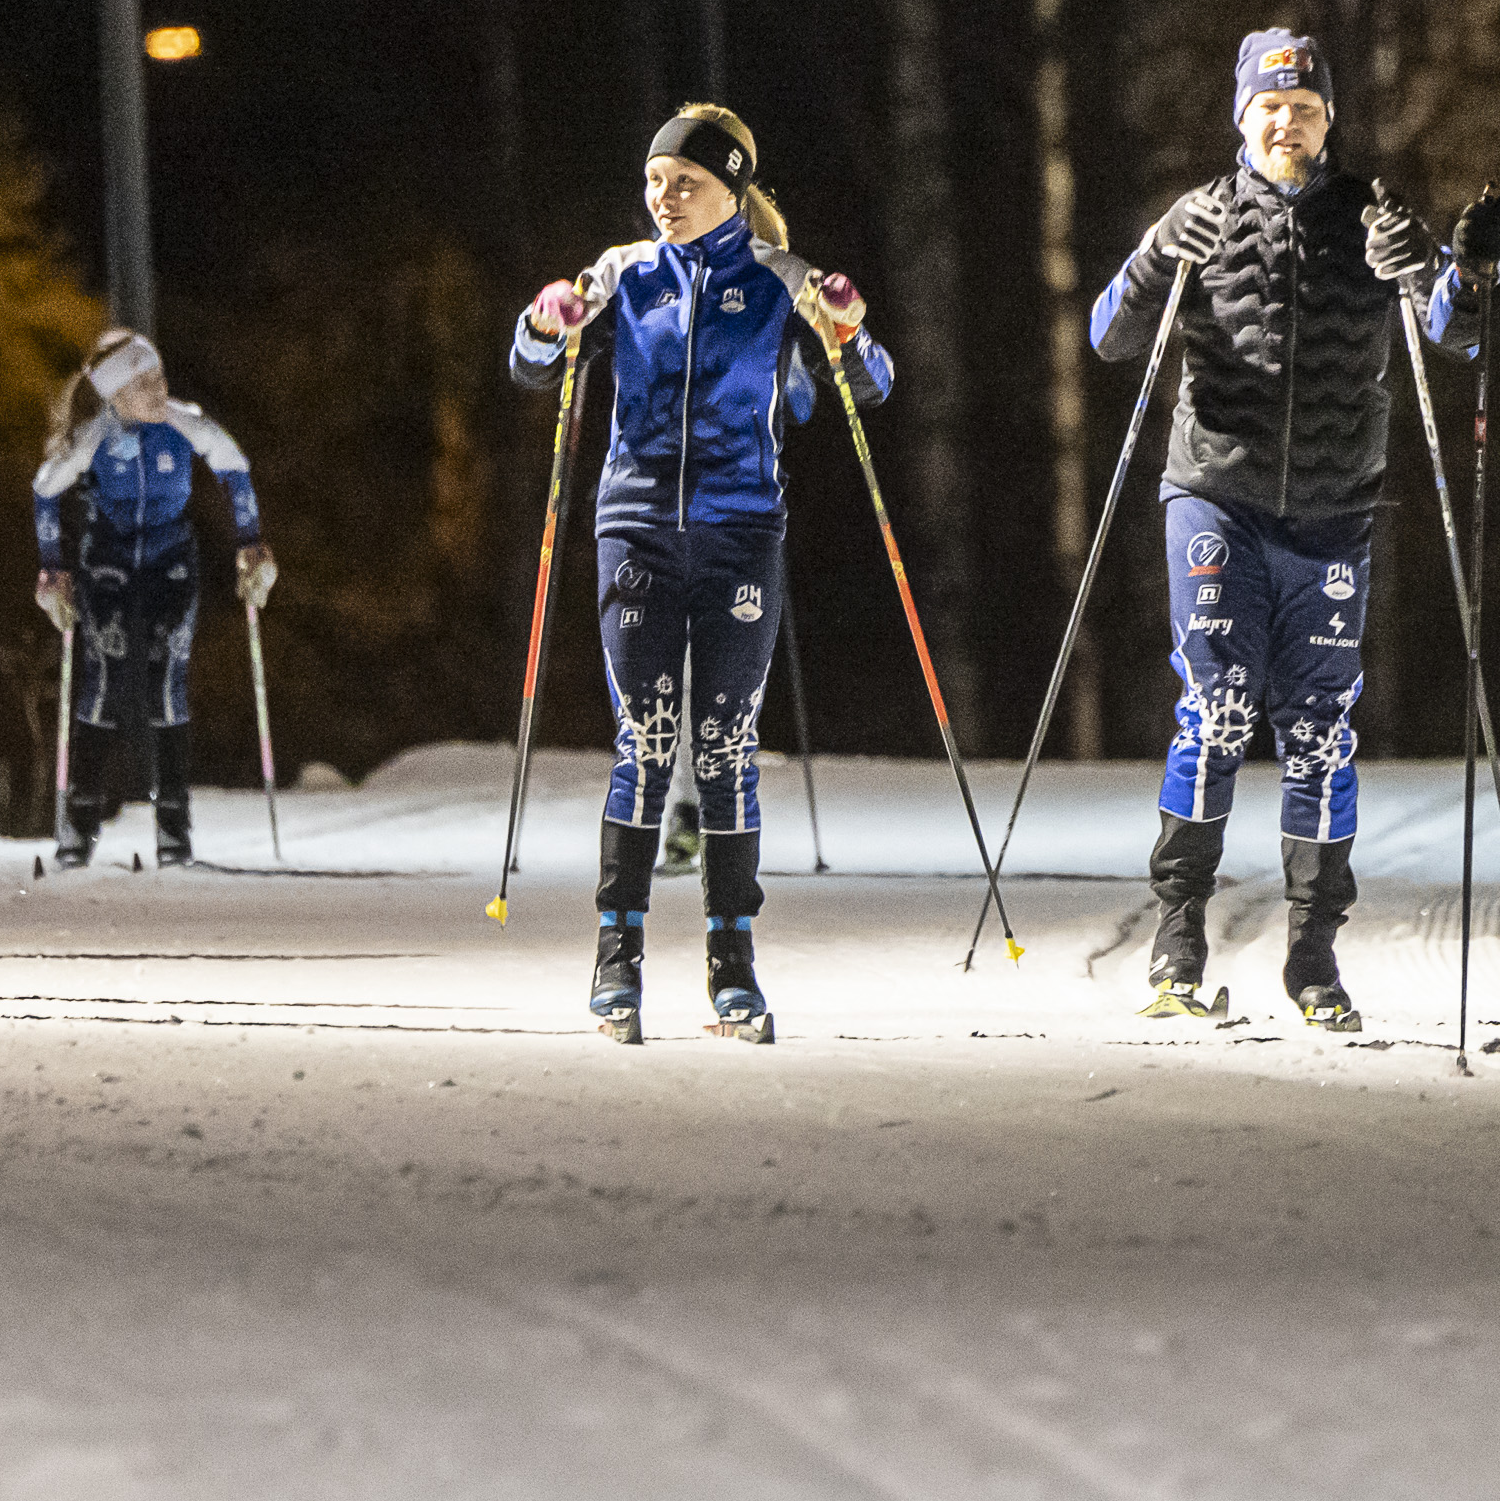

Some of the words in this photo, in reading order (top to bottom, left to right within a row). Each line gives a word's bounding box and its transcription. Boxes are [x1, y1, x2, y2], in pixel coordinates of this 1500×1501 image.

[1326, 563, 1354, 585] OH
[734, 584, 762, 608] OH
[1309, 636, 1359, 648] KEMIJOKI
